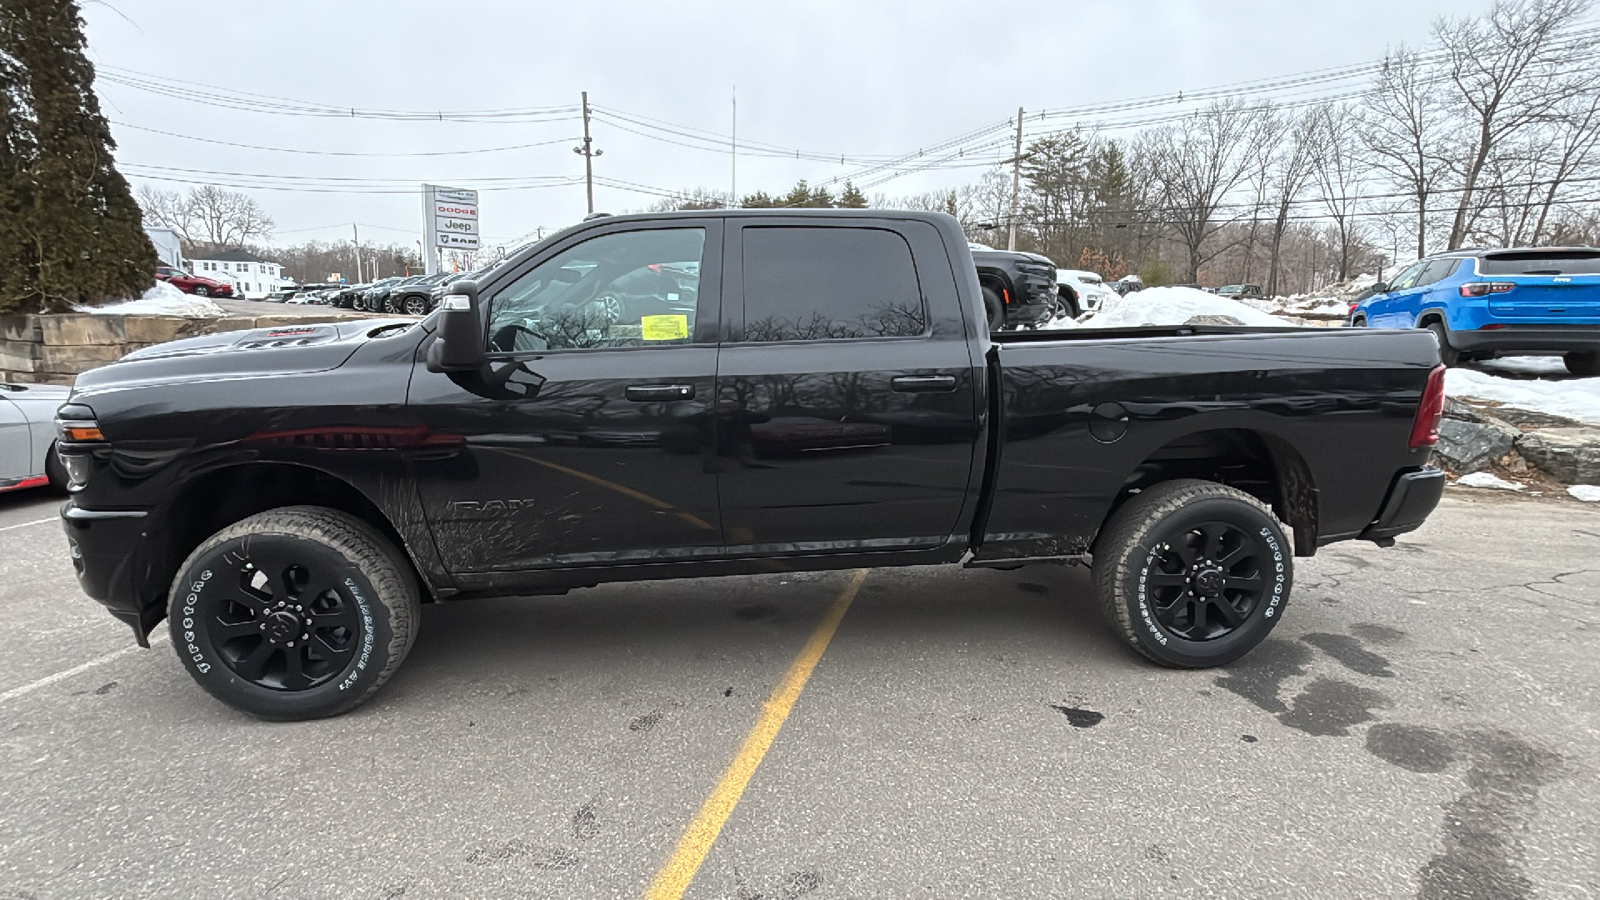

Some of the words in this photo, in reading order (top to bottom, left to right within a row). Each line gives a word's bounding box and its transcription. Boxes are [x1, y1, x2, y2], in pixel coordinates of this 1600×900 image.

[438, 207, 476, 215] DODGE
[445, 220, 471, 232] Jeep
[452, 498, 535, 519] RAM
[1138, 567, 1168, 646] TRANSFORCE
[344, 577, 374, 671] TRANSFORCE
